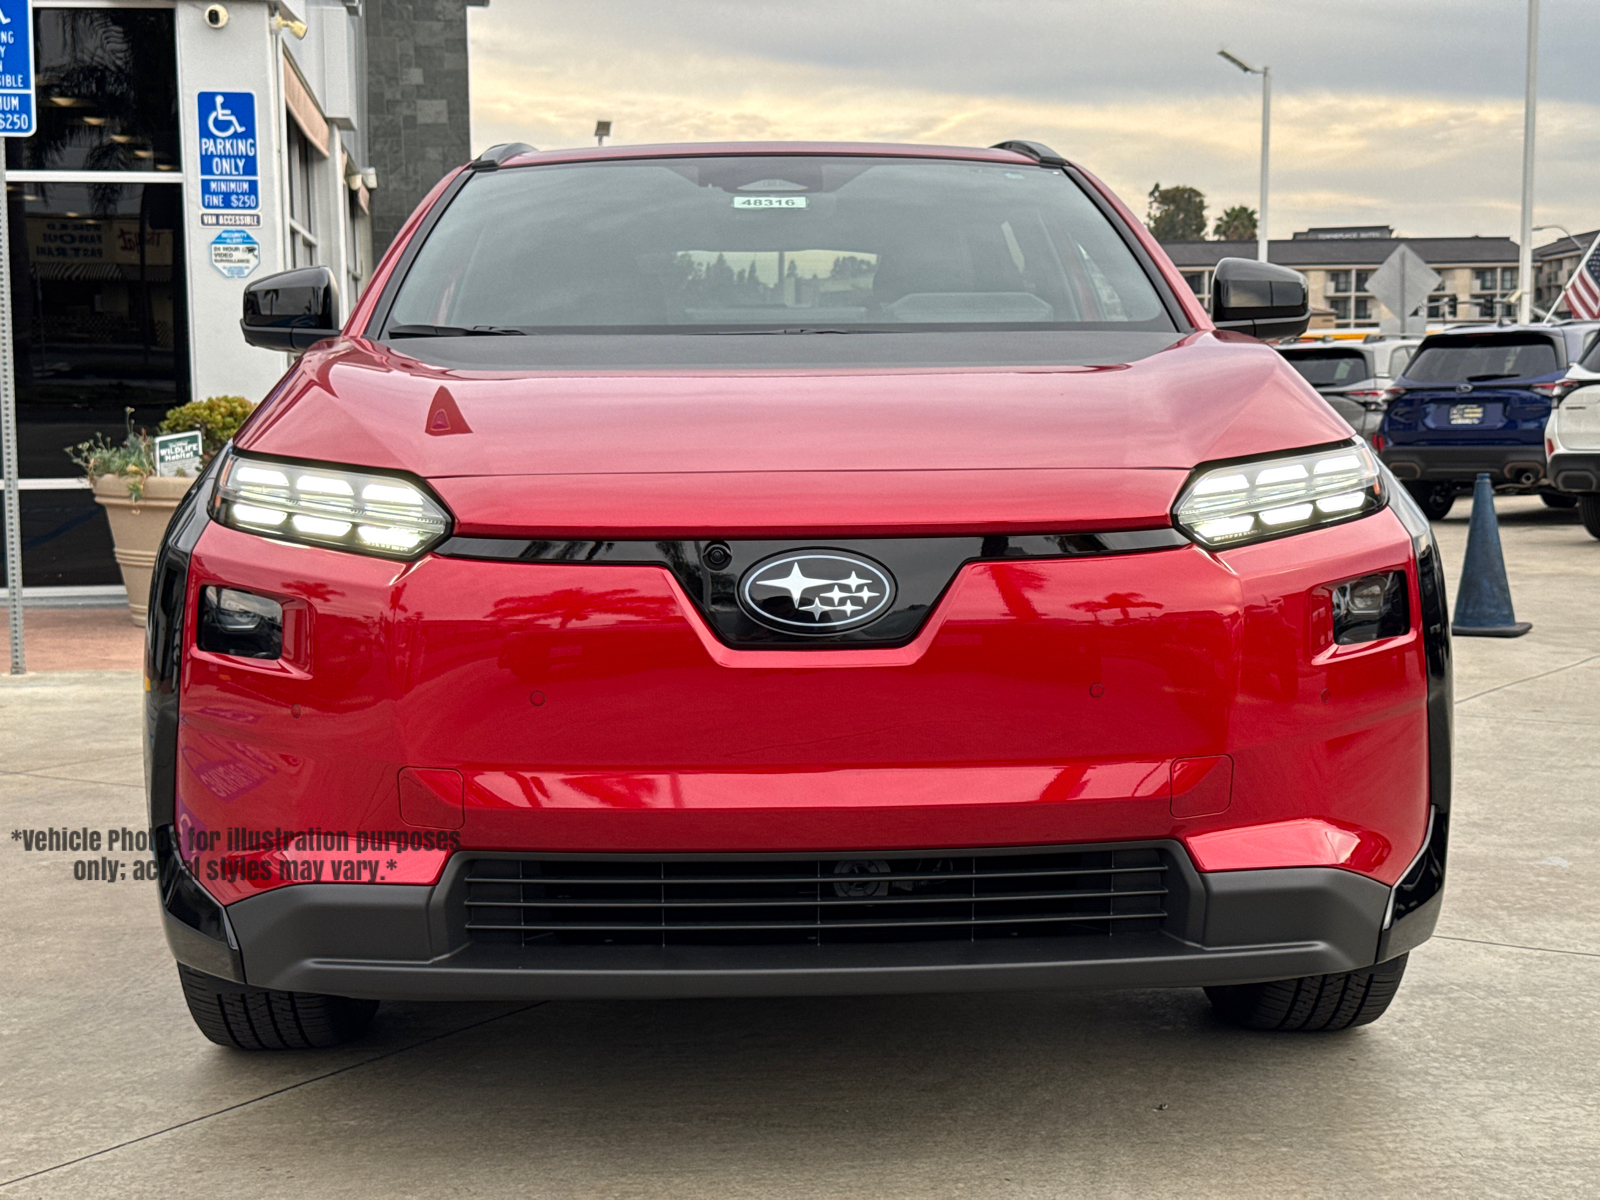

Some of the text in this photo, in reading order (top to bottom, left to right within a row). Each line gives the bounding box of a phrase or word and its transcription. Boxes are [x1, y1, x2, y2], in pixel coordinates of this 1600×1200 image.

[201, 138, 255, 156] PARKING
[212, 157, 246, 175] ONLY
[210, 181, 250, 193] MINIMUM
[204, 194, 257, 208] FINE $250
[203, 215, 258, 225] VAN ACCESSIBLE
[160, 443, 198, 456] WILDLIFE
[165, 451, 194, 461] Habitat
